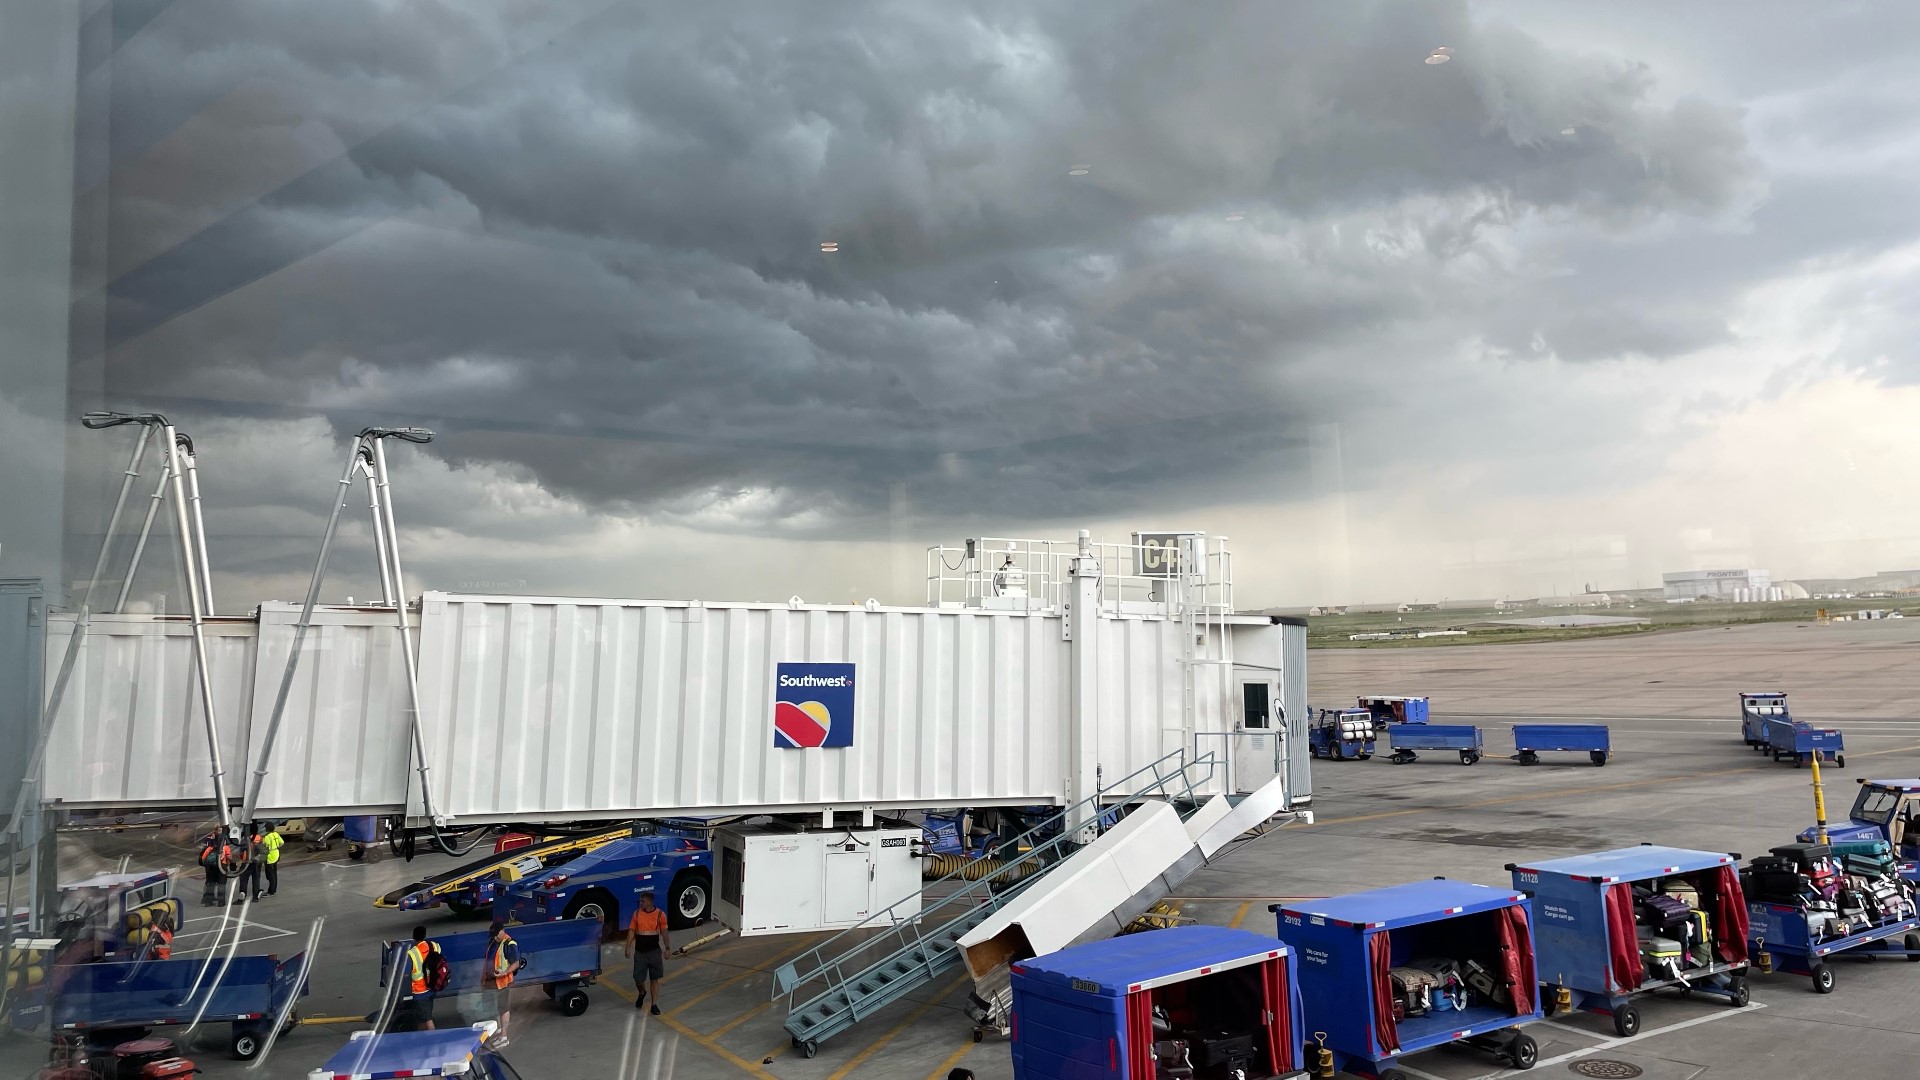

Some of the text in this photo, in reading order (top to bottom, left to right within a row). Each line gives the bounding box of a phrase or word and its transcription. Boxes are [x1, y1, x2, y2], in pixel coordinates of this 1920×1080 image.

[1144, 538, 1191, 569] C4
[1707, 570, 1744, 578] FRONTIER
[780, 674, 846, 687] Southwest
